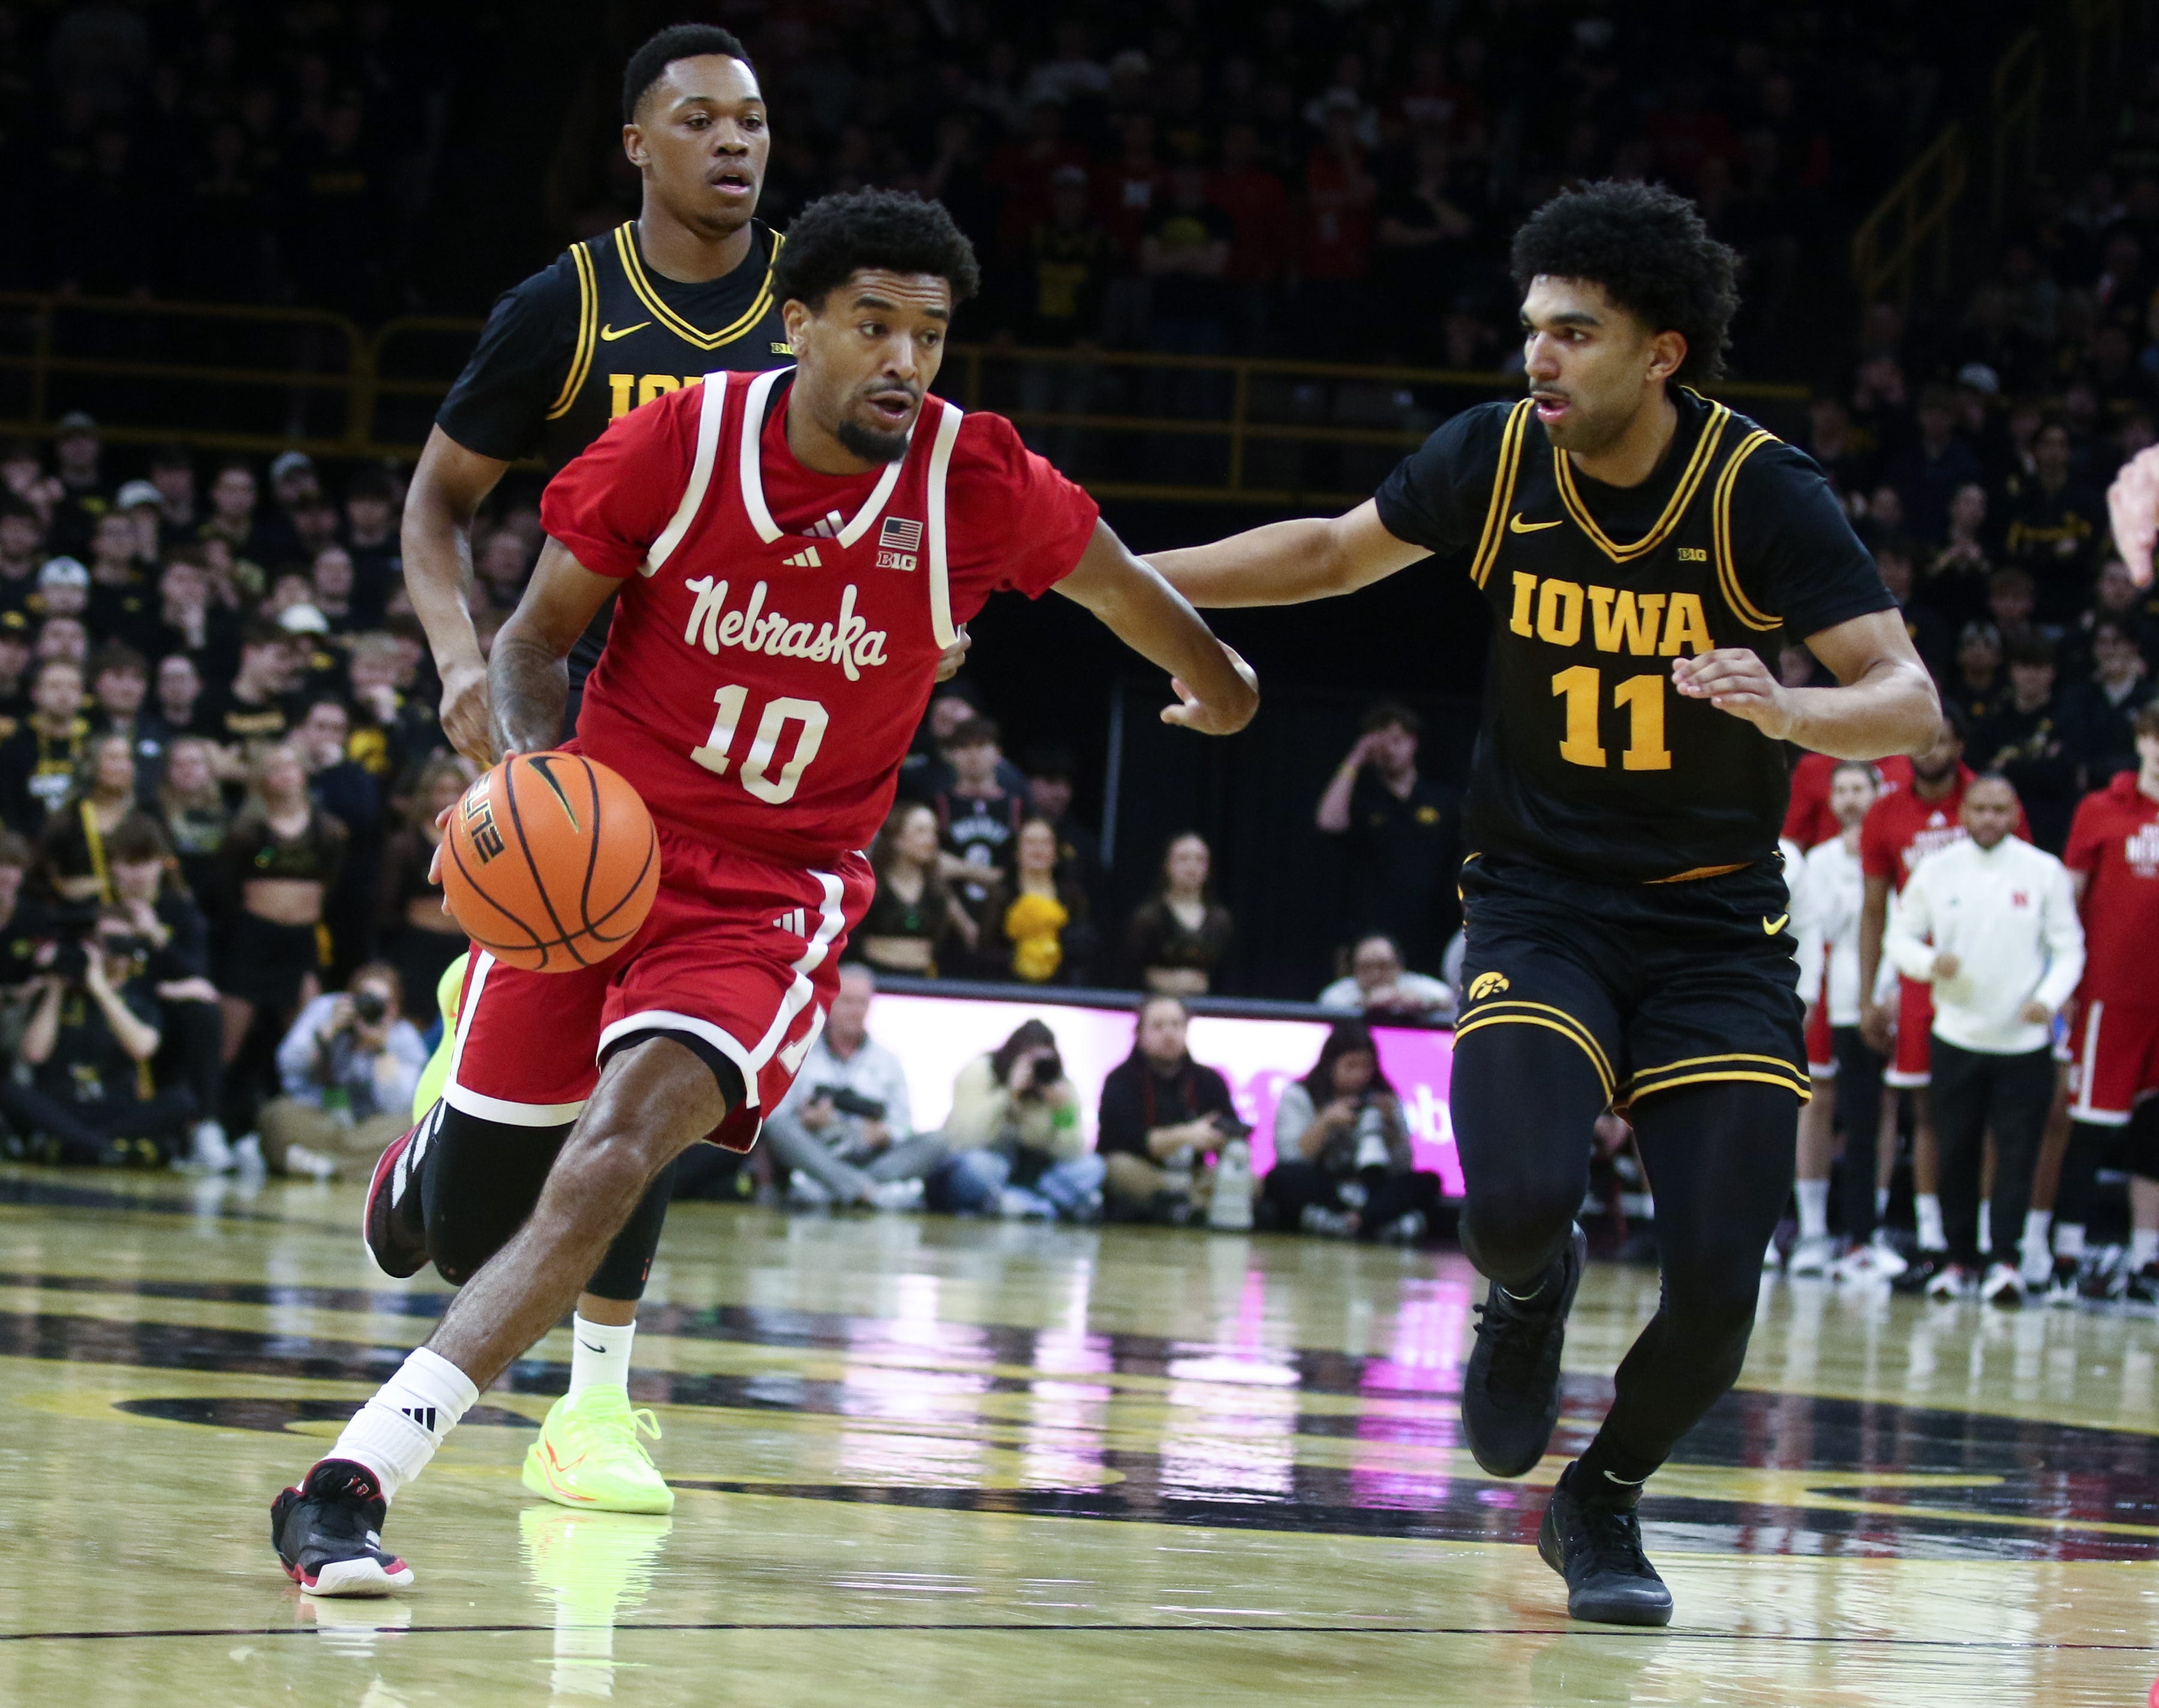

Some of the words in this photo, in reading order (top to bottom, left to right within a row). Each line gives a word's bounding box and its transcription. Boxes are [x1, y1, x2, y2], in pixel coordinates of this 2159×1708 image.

[684, 575, 888, 682] Nebraska
[1510, 570, 1715, 657] IOWA
[690, 684, 830, 805] 10
[1551, 664, 1672, 771] 11
